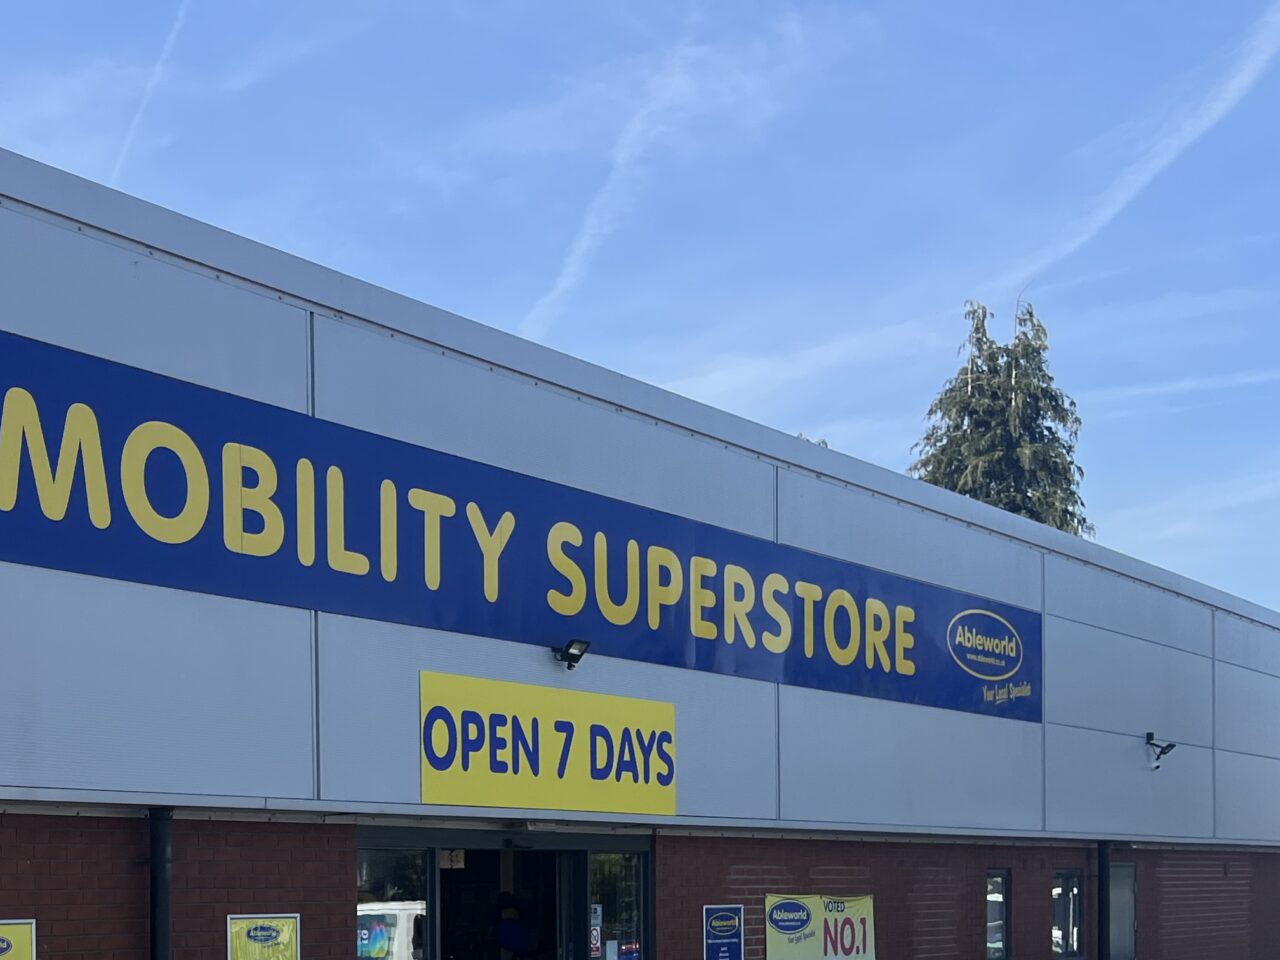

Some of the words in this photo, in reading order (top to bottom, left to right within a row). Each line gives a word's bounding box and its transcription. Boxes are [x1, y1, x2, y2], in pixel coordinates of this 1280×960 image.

[546, 521, 917, 677] SUPERSTORE
[955, 625, 1017, 658] Ableworld
[983, 684, 995, 702] Your
[422, 705, 540, 778] OPEN
[552, 720, 575, 780] 7
[589, 726, 675, 787] DAYS
[773, 910, 808, 920] Ableworld
[823, 900, 846, 912] VOTED
[823, 916, 868, 957] NO.1
